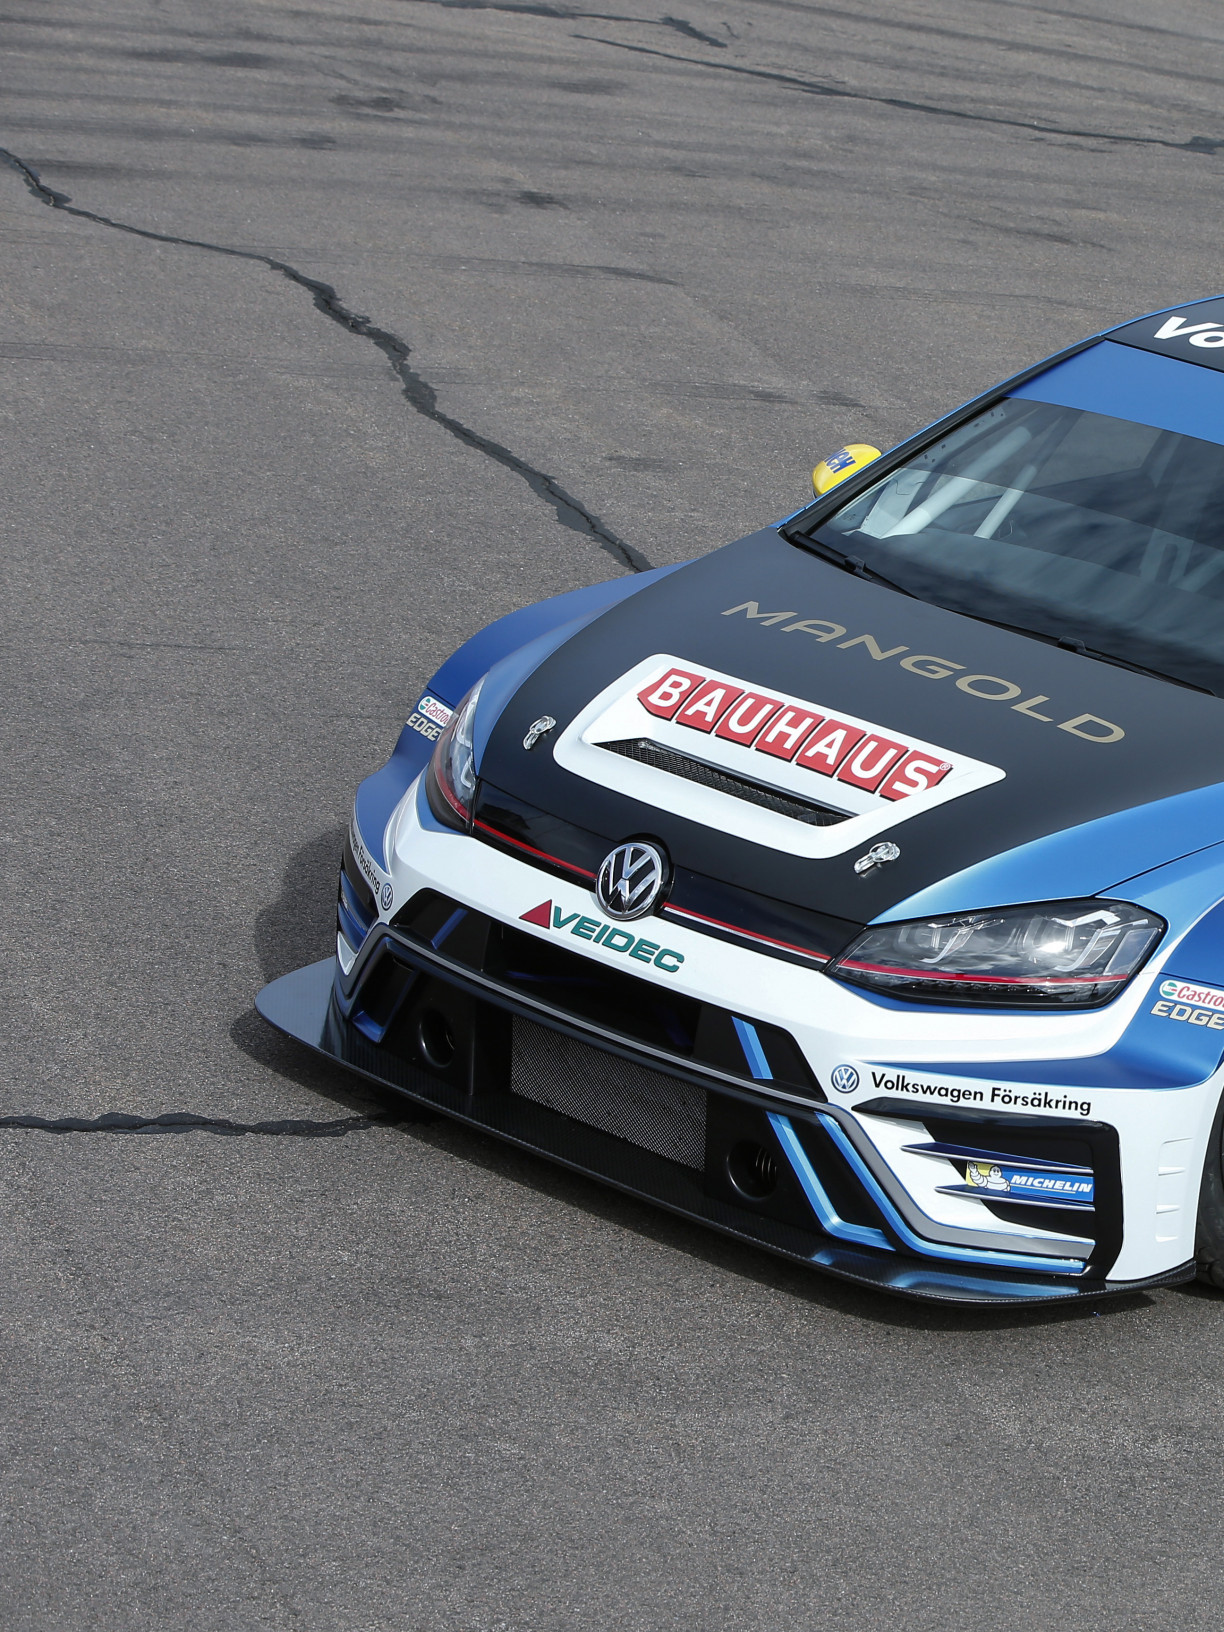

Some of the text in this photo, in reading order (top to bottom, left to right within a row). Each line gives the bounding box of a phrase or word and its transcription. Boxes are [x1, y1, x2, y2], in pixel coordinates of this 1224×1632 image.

[720, 600, 1126, 744] MANGOLD
[406, 712, 442, 742] EDGE
[644, 673, 949, 798] BAUHAUS
[552, 906, 685, 973] VEIDEC
[871, 1071, 1092, 1116] Volkswagen Försäkring
[1010, 1174, 1093, 1194] MICHELIN
